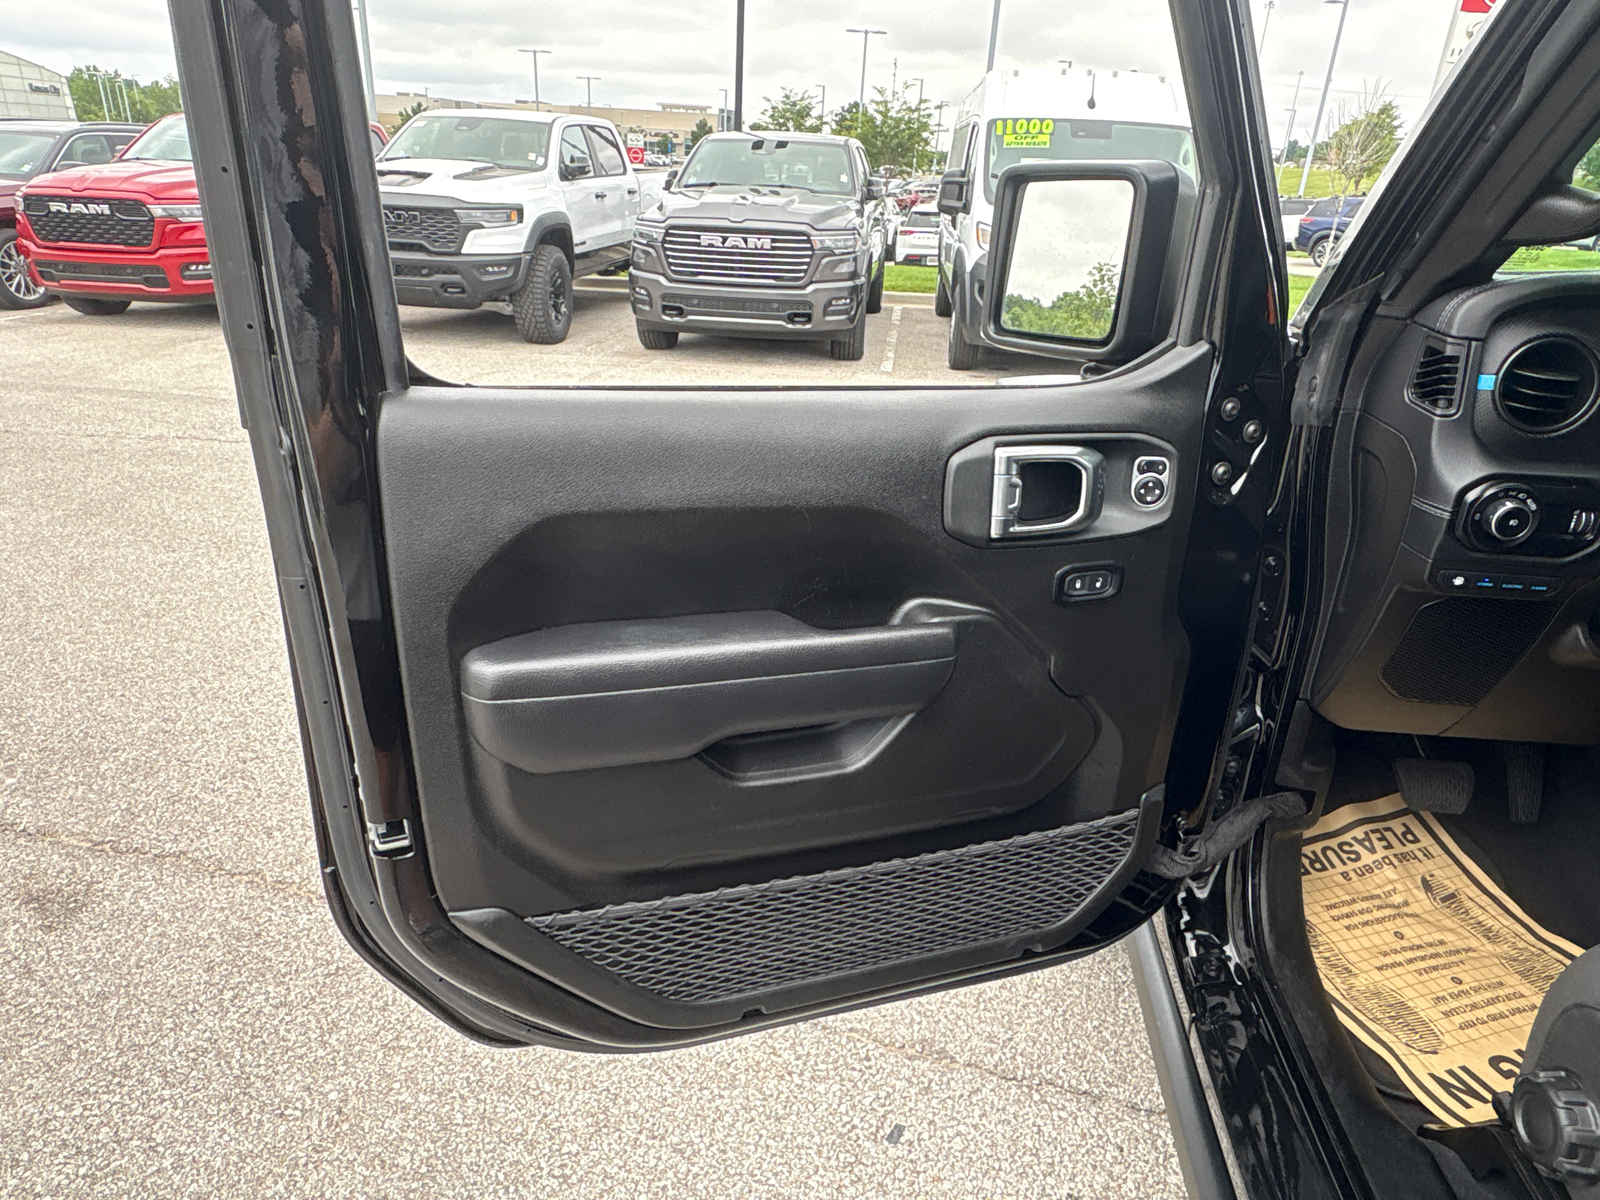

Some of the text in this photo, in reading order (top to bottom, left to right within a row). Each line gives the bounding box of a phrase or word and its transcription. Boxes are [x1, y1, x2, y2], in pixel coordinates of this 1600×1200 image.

[996, 118, 1054, 135] 11000
[48, 202, 111, 215] RAM
[382, 210, 420, 224] AM
[700, 235, 771, 250] RAM
[1340, 846, 1435, 881] It has been a
[1344, 923, 1359, 932] FOR
[1430, 980, 1507, 1005] WITH THIS PAPER MAT
[1441, 991, 1526, 1018] YOUR CARPETING CLEAN
[1475, 1016, 1489, 1026] TO
[1486, 1010, 1510, 1022] TRIED
[1459, 1020, 1478, 1030] KEEP
[1426, 1065, 1499, 1110] IN
